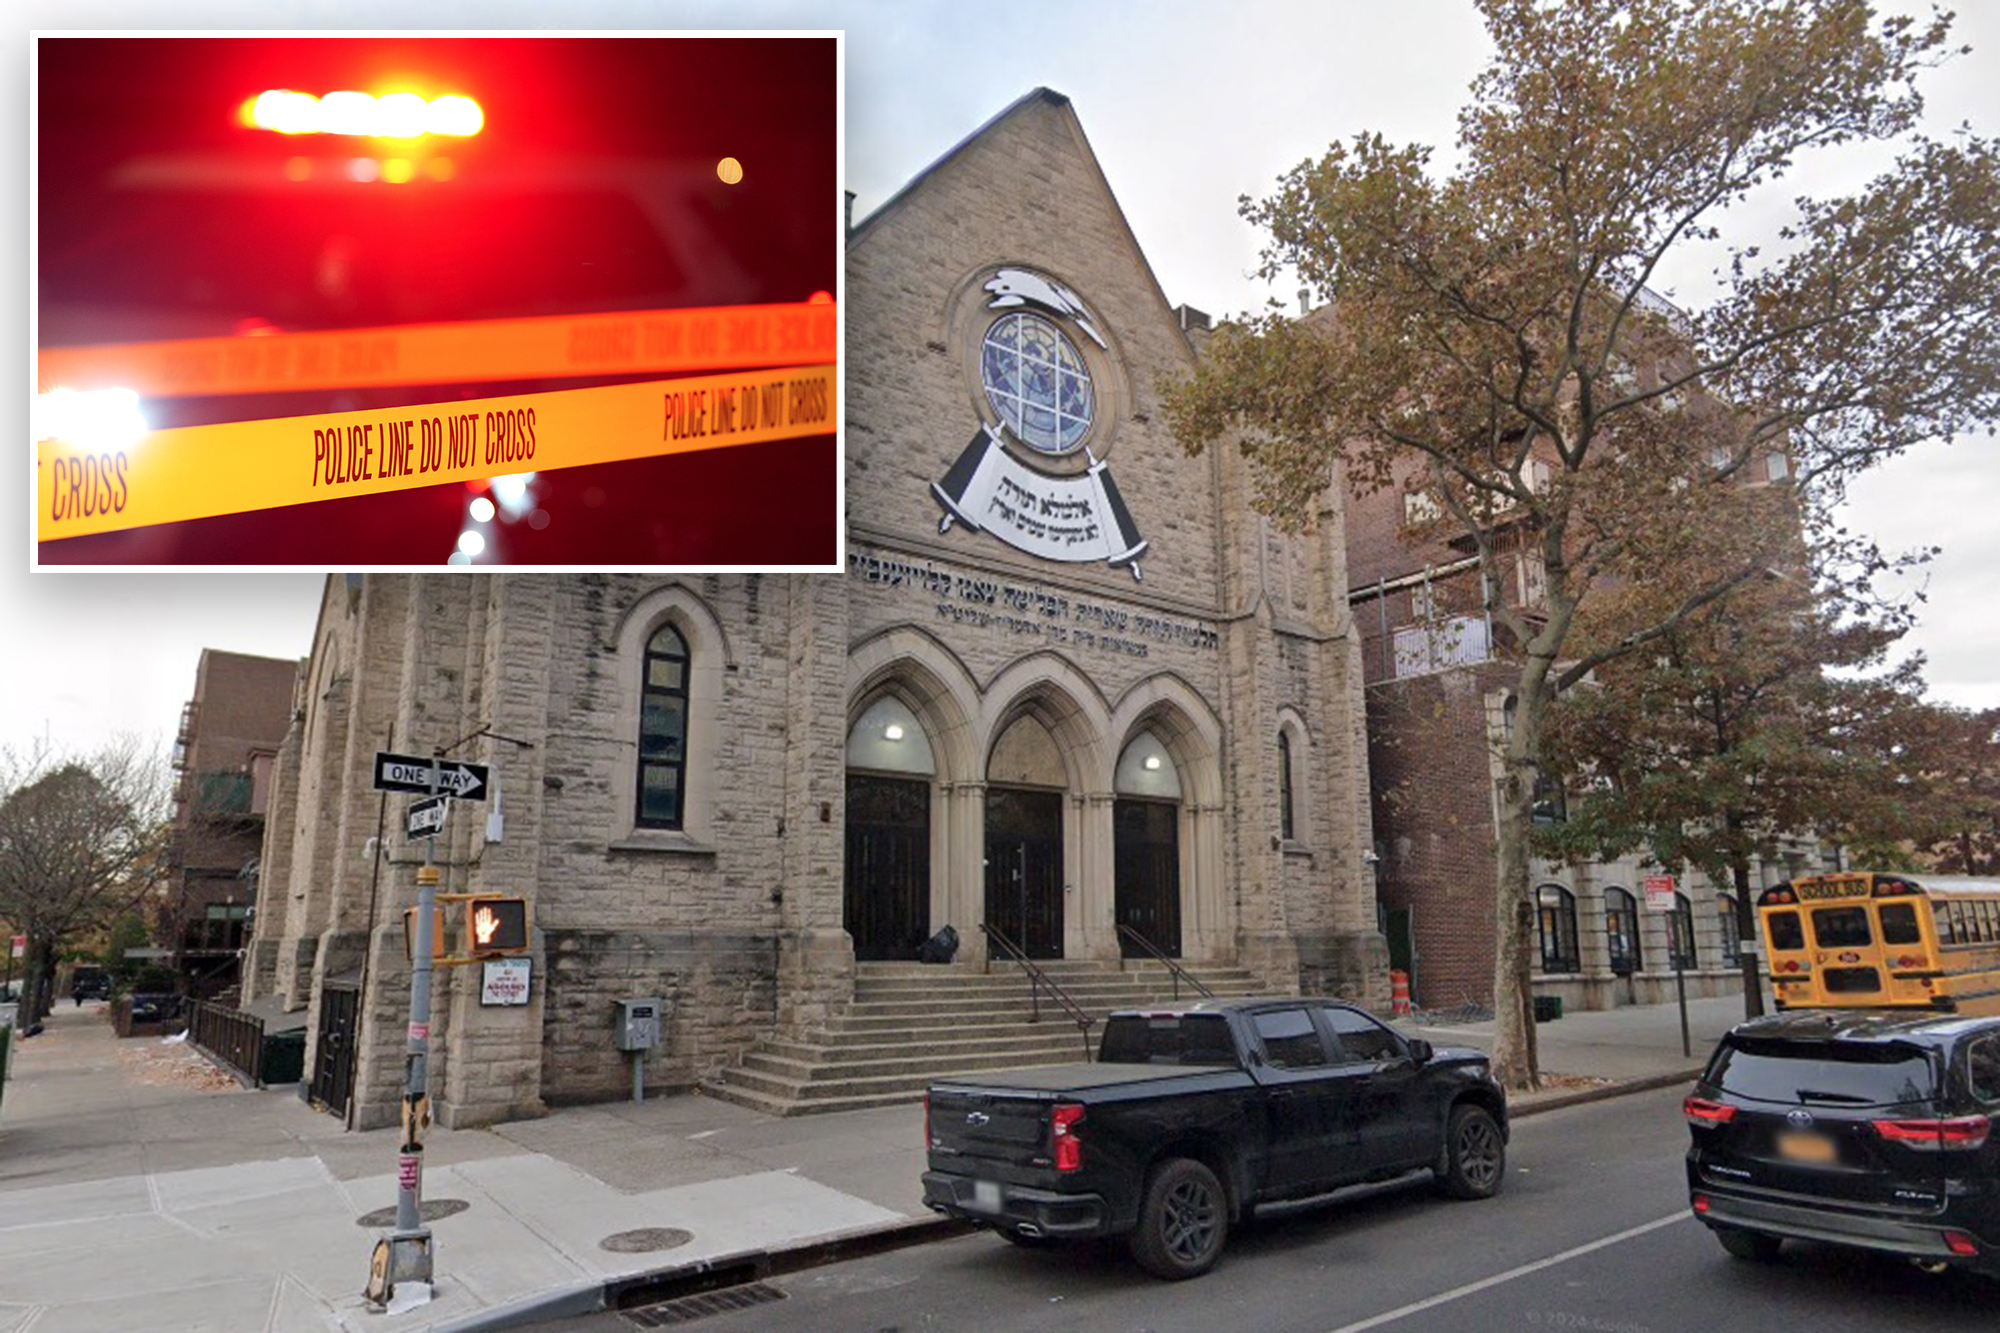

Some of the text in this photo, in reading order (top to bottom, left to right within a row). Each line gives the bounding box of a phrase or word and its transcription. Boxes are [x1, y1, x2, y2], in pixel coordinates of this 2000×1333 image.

[663, 377, 828, 441] POLICE LINE DO NOT CROSS
[312, 408, 536, 486] POLICE LINE DO NOT CROSS
[52, 451, 128, 521] CROSS
[997, 476, 1037, 511] תורה
[392, 766, 472, 789] ONE WAY
[1842, 881, 1868, 897] BUS
